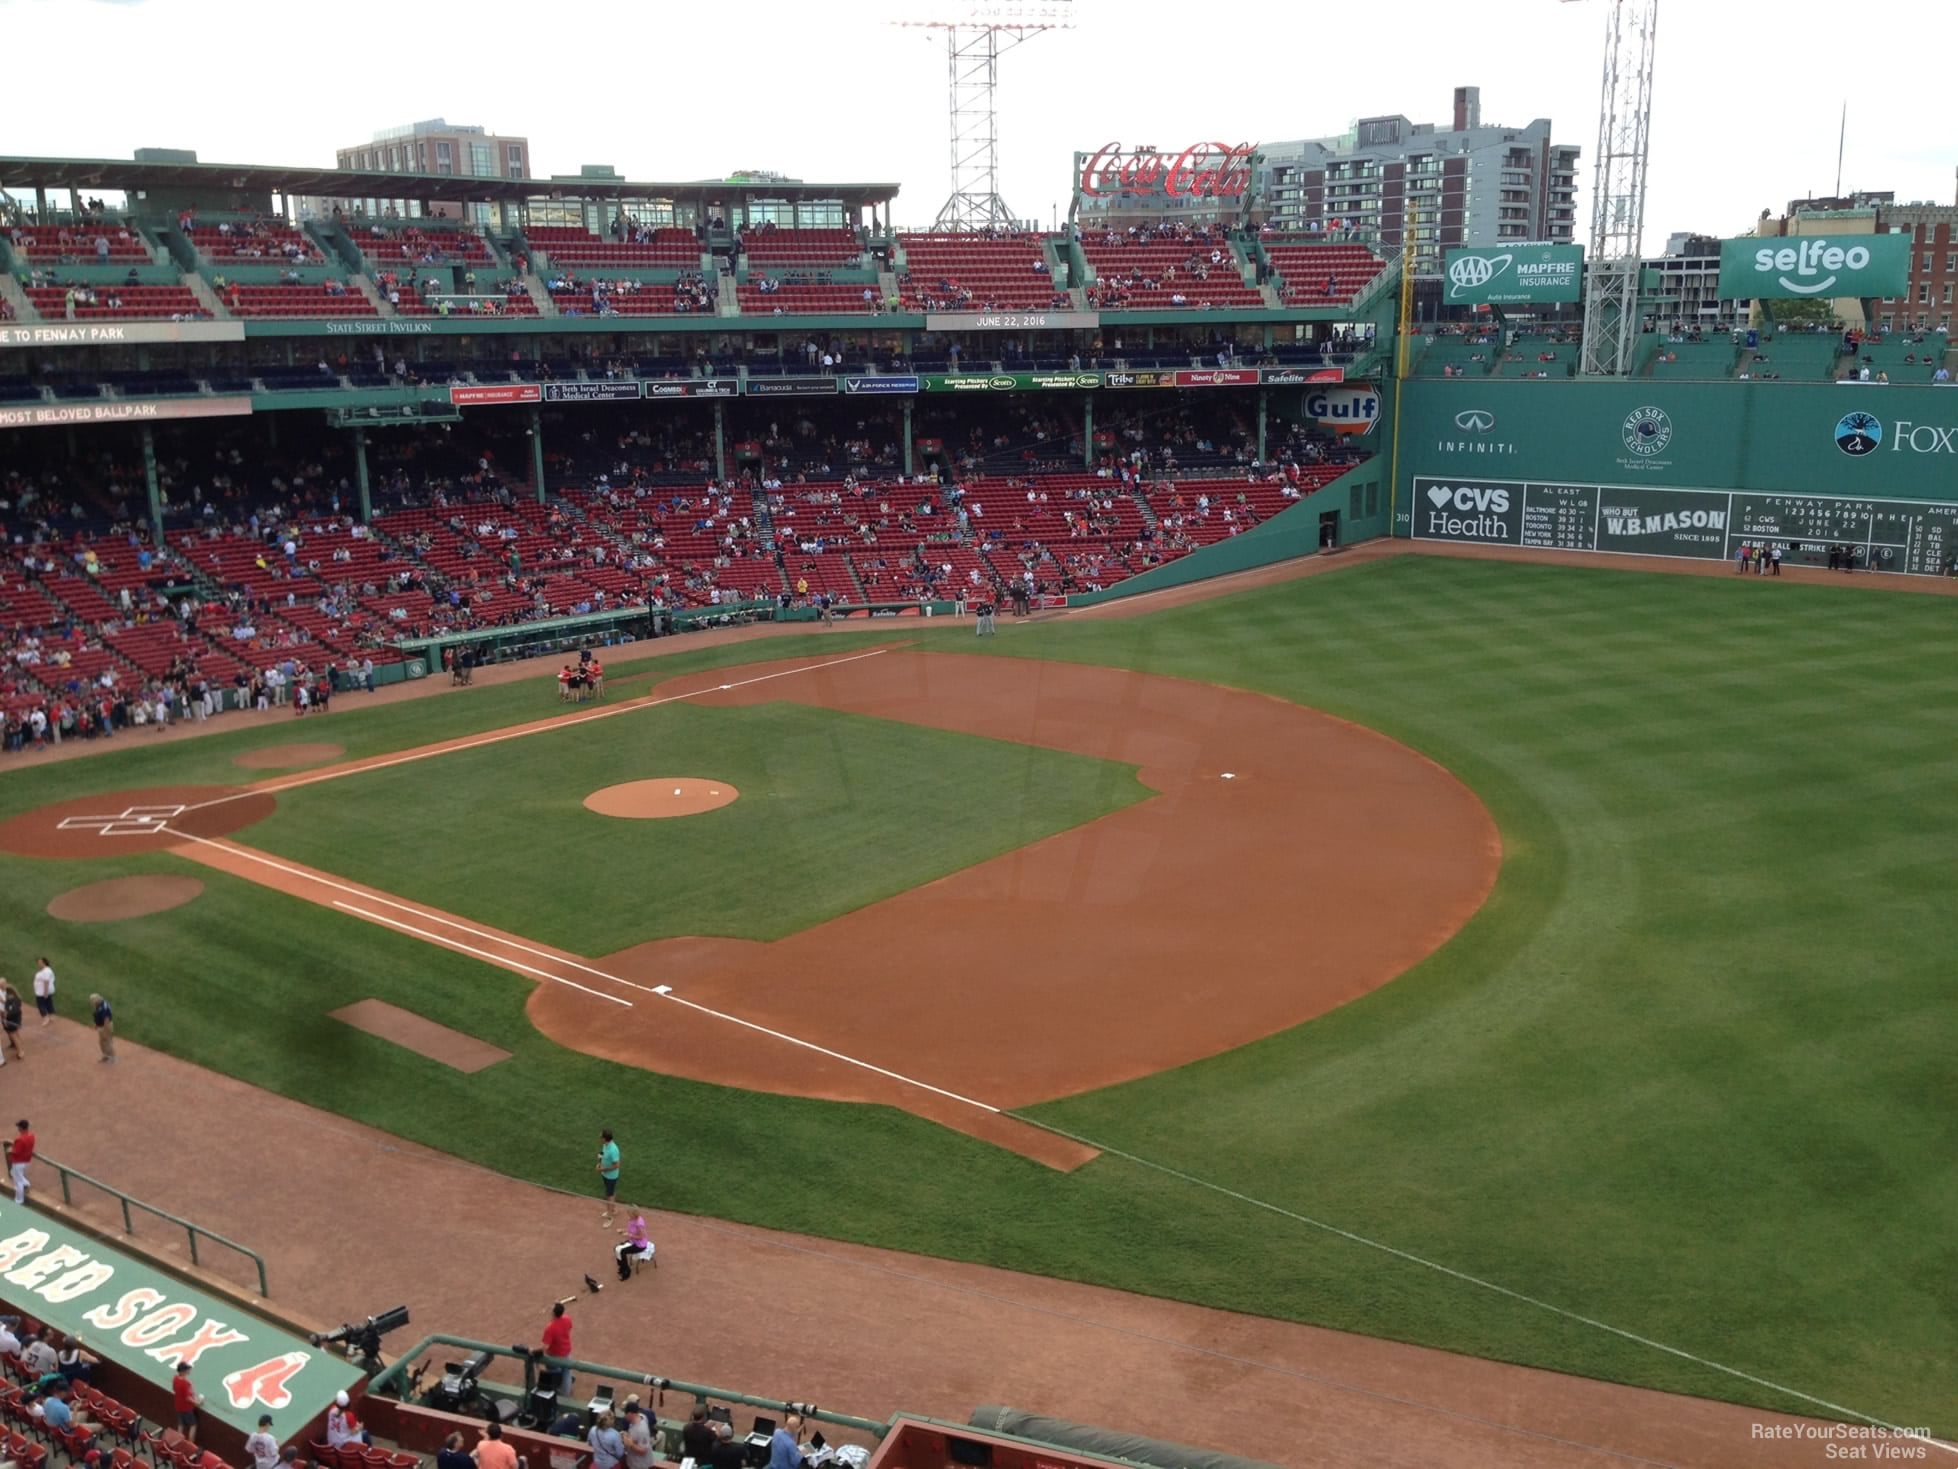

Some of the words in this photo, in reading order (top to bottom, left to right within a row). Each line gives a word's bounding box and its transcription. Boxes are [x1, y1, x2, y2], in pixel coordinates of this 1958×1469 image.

[1517, 263, 1575, 274] MAPFRE
[1520, 277, 1570, 286] INSURANCE
[977, 317, 1000, 326] JUNE
[1005, 317, 1020, 327] 22,
[1024, 316, 1045, 326] 2016
[15, 330, 30, 342] TO
[35, 328, 86, 341] FENWAY
[91, 328, 124, 340] PARK
[1108, 374, 1134, 385] Tribe
[1307, 395, 1376, 418] Gulf
[37, 408, 90, 421] BELOVED
[96, 406, 157, 418] BALLPARK
[1626, 410, 1642, 430] RED
[1646, 408, 1664, 421] SOX
[1626, 427, 1669, 453] SCHOLARS
[1438, 442, 1512, 454] INFINITI
[1454, 487, 1509, 513] CVS
[1766, 498, 1823, 507] FENWAY
[1835, 502, 1873, 510] PARK
[1526, 506, 1556, 514] BALTIMORE
[1602, 508, 1620, 516] WHO
[1622, 508, 1638, 516] BUT
[1928, 507, 1957, 516] AMER
[1396, 513, 1409, 522] 310
[1799, 519, 1829, 527] JUNE
[1428, 512, 1508, 538] Health
[1526, 522, 1552, 530] TORONTO
[1752, 525, 1779, 533] BOSTON
[1674, 534, 1699, 542] SINCE
[1808, 529, 1839, 537] 2016
[1800, 544, 1826, 552] STRIKE
[0, 1228, 114, 1303] RED
[82, 1288, 249, 1369] SOX
